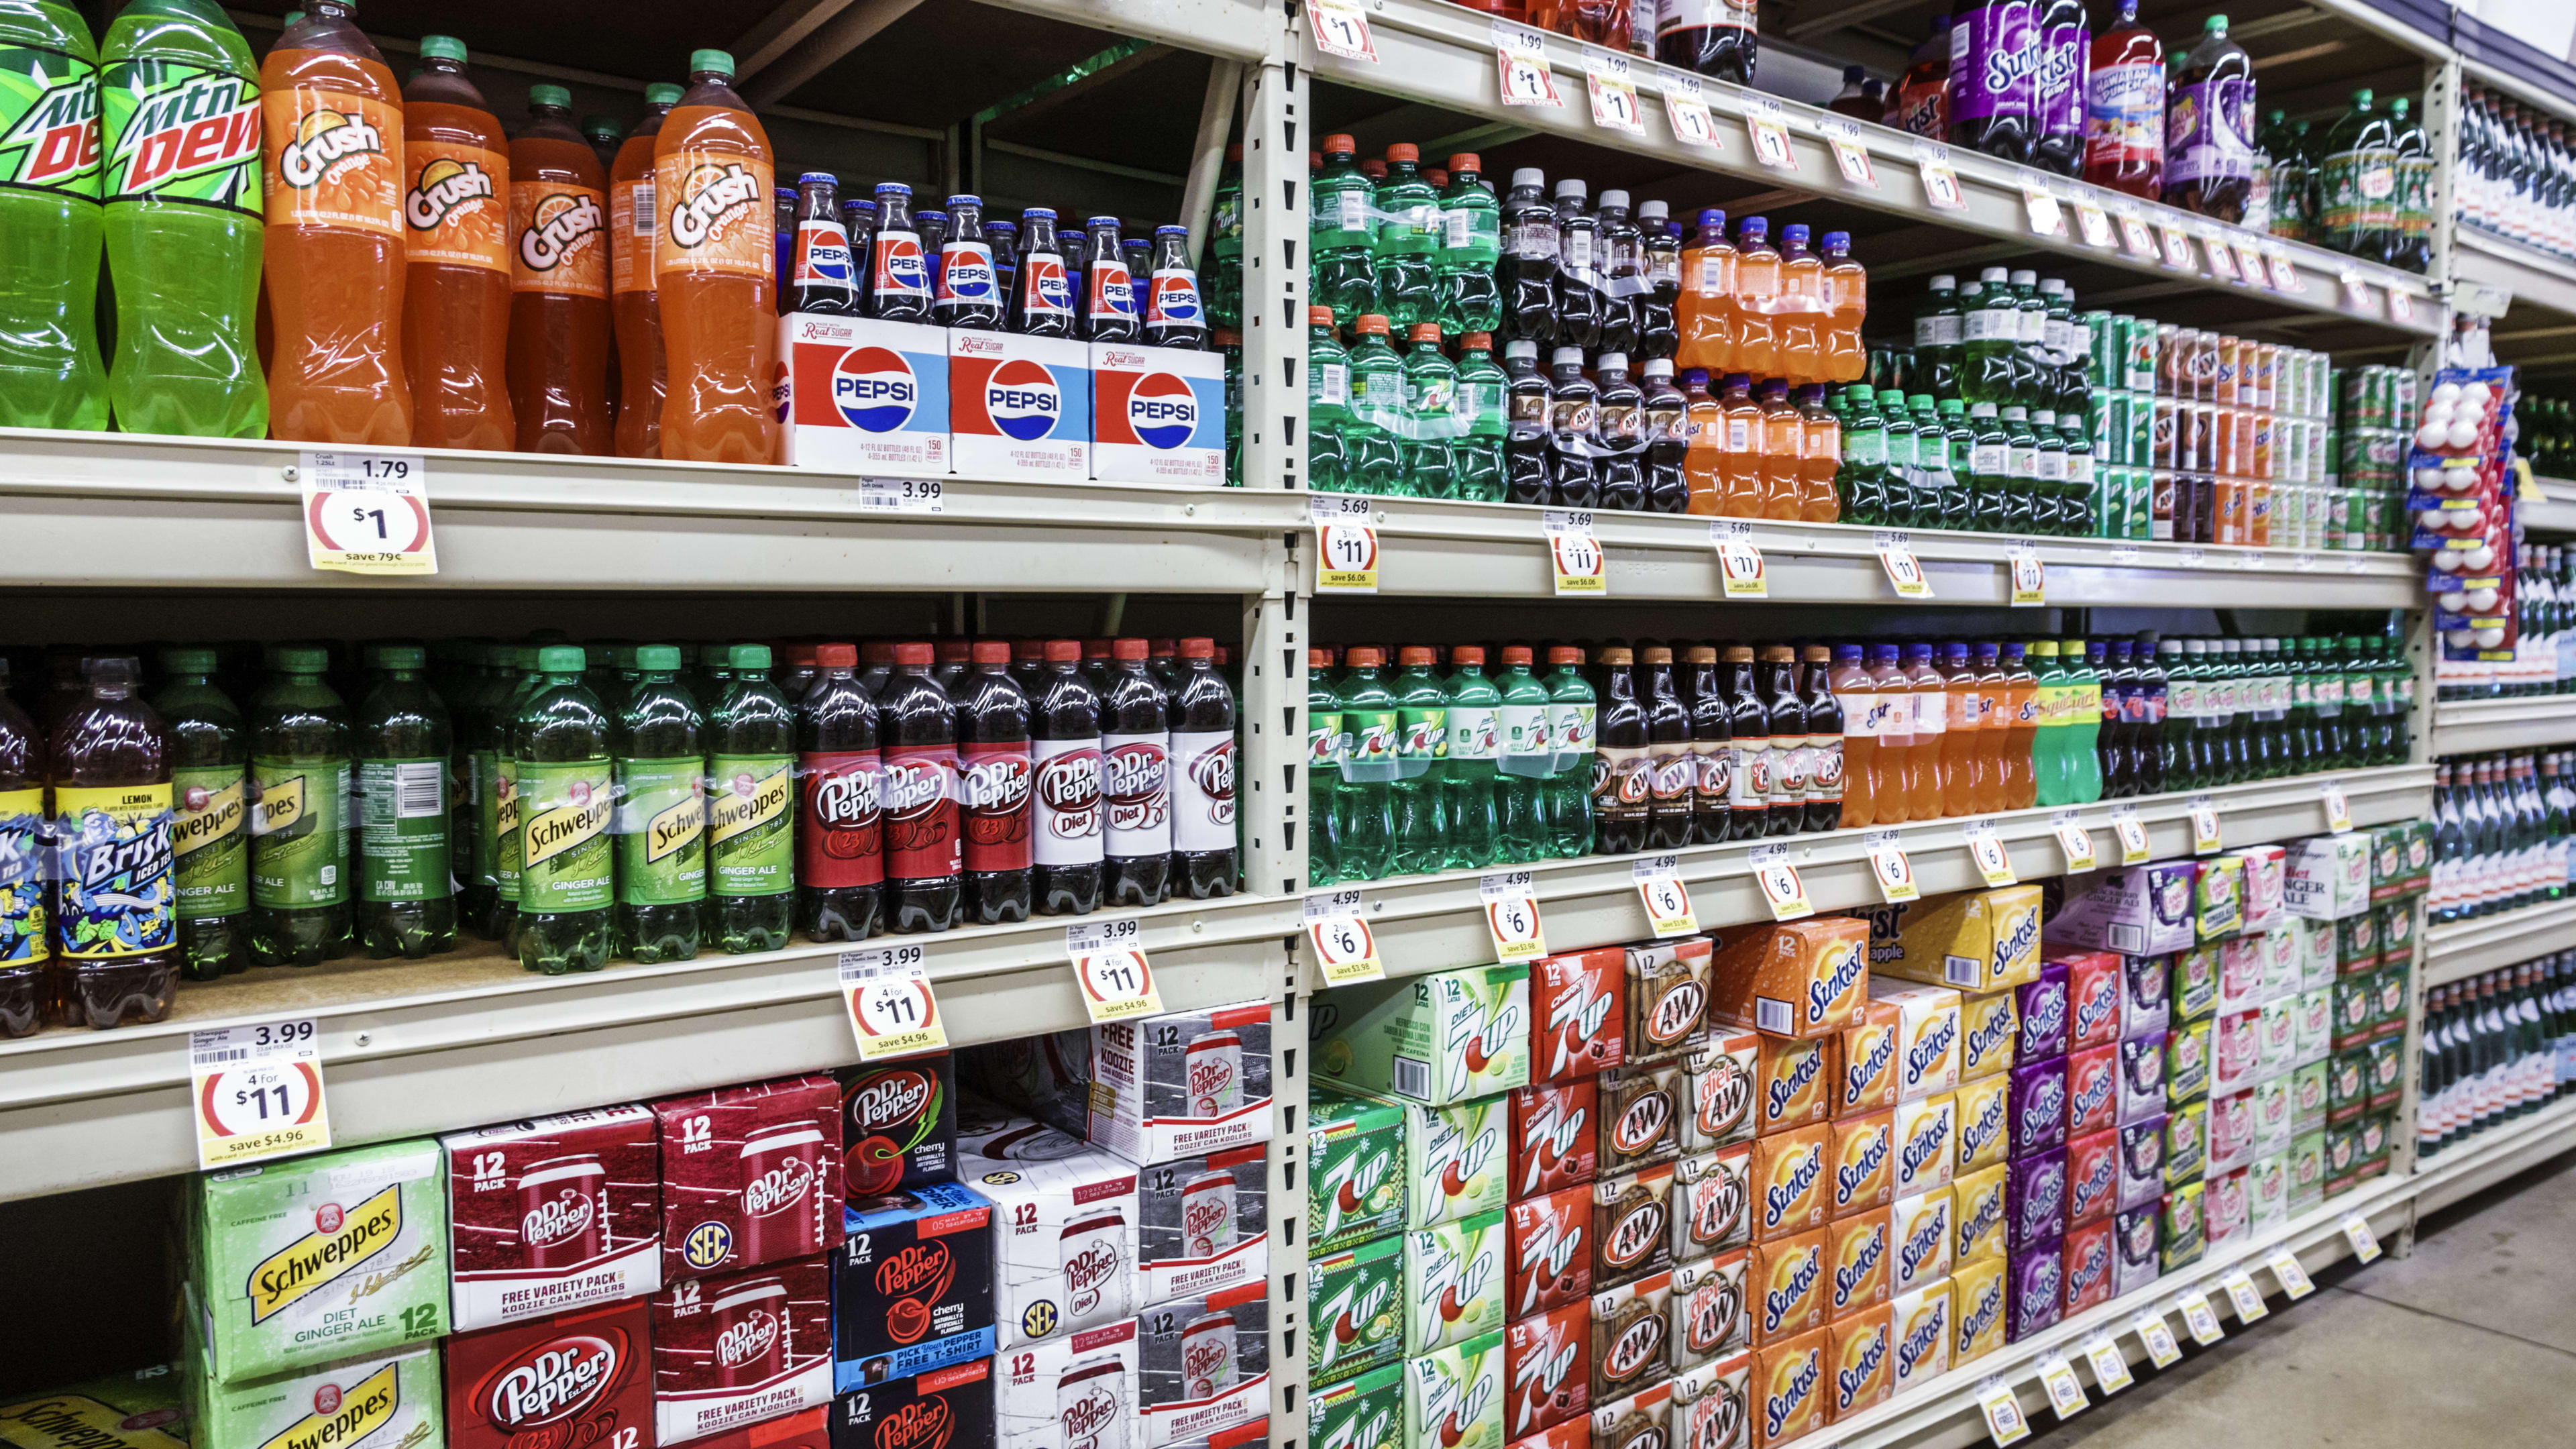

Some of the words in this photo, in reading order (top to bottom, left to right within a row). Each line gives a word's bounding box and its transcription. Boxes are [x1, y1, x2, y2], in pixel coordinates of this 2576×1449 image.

[1331, 17, 1354, 45] $1
[1519, 33, 1542, 50] 1.99
[1324, 43, 1348, 58] DOWN
[1348, 47, 1374, 62] DOWN
[1519, 71, 1538, 95] $1
[1680, 76, 1700, 93] 1.99
[122, 78, 236, 146] Mtn
[1684, 111, 1701, 135] $1
[1841, 123, 1859, 138] 1.99
[282, 114, 380, 189] Crush
[1931, 147, 1947, 160] 1.99
[326, 154, 371, 185] Orange
[407, 163, 492, 229] Crush
[673, 165, 759, 247] Crush
[445, 199, 484, 227] Orange
[708, 203, 750, 242] Orange
[521, 197, 603, 269] Crush
[560, 232, 596, 267] Orange
[948, 269, 991, 281] PEPSI
[1159, 294, 1197, 304] PEPSI
[802, 322, 830, 339] Real
[831, 328, 853, 337] SUGAR
[985, 342, 1004, 352] SUGAR
[1128, 356, 1145, 365] SUGAR
[837, 378, 914, 401] PEPSI
[989, 389, 1057, 411] PEPSI
[1131, 400, 1195, 421] PEPSI
[883, 444, 901, 453] BOTTLES
[928, 440, 941, 450] 150
[1071, 448, 1082, 458] 150
[362, 460, 409, 479] 1.79
[1208, 455, 1219, 465] 150
[902, 482, 941, 499] 3.99
[1341, 498, 1368, 514] 5.69
[354, 507, 387, 539] $1
[1568, 513, 1592, 526] 5.69
[1731, 523, 1751, 535] 5.69
[1891, 531, 1909, 543] 5.69
[345, 553, 376, 561] save
[378, 553, 402, 561] 79¢
[1338, 539, 1362, 562] $11
[1347, 574, 1366, 582] $6.06
[1355, 723, 1396, 759] 7UP
[1403, 720, 1446, 755] 7UP
[1556, 716, 1595, 751] 7UP
[991, 761, 1019, 784] Dr
[1123, 751, 1152, 772] Dr
[122, 794, 152, 805] LEMON
[970, 767, 1030, 810] Pepper
[1061, 814, 1087, 833] Diet
[1114, 806, 1139, 824] Diet
[1979, 818, 1996, 830] 4.99
[733, 830, 762, 846] SINCE
[765, 817, 784, 831] 1783
[981, 819, 1000, 835] 23
[842, 833, 860, 848] 23
[1769, 843, 1787, 855] 4.99
[136, 859, 159, 883] ICED
[719, 866, 756, 875] GINGER
[758, 865, 777, 874] ALE
[1655, 855, 1676, 868] 4.99
[215, 883, 235, 894] ALE
[552, 879, 594, 891] GINGER
[596, 875, 610, 885] ALE
[1506, 871, 1529, 885] 4.99
[1332, 890, 1360, 905] 4.99
[1104, 920, 1137, 938] 3.99
[1507, 912, 1524, 934] $6
[1334, 931, 1356, 954] $6
[1994, 904, 2039, 975] Sunkist
[882, 947, 921, 966] 3.99
[1870, 943, 1903, 962] apple
[1100, 967, 1135, 991] $11
[1352, 963, 1370, 973] $3.98
[1445, 978, 1460, 997] 12
[1550, 973, 1587, 1009] CHERRY
[1809, 941, 1864, 1022] Sunkist
[876, 996, 916, 1024] $11
[1451, 1000, 1474, 1026] DIET
[1658, 981, 1696, 1038] A&W
[2024, 981, 2065, 1052] Sunkist
[256, 1021, 313, 1046] 3.99
[878, 1038, 900, 1049] save
[901, 1032, 928, 1045] $4.96
[1158, 1025, 1179, 1046] 12
[1548, 988, 1613, 1080] 7UP
[1158, 1046, 1179, 1056] PACK
[1447, 1003, 1519, 1103] 7UP
[1907, 1012, 1957, 1085] Sunkist
[1101, 1047, 1135, 1076] KOOZIE
[1846, 1024, 1894, 1104] Sunkist
[248, 1075, 257, 1085] 4
[261, 1073, 279, 1084] for
[879, 1078, 908, 1101] Dr
[1700, 1058, 1734, 1098] diet
[1768, 1040, 1825, 1120] Sunkist
[236, 1084, 290, 1120] $11
[862, 1083, 924, 1128] Pepper
[1709, 1073, 1743, 1129] A&W
[682, 1115, 712, 1143] 12
[229, 1139, 262, 1152] save
[265, 1130, 304, 1146] $4.96
[684, 1140, 712, 1154] PACK
[914, 1142, 945, 1155] cherry
[472, 1151, 506, 1181] 12
[474, 1178, 506, 1193] PACK
[1766, 1142, 1823, 1228] Sunkist
[230, 1215, 268, 1227] CAFFEINE
[269, 1211, 288, 1221] FREE
[526, 1203, 589, 1246] Pepper
[1015, 1202, 1038, 1226] 12
[1016, 1224, 1038, 1236] PACK
[1615, 1203, 1655, 1261] A&W
[260, 1208, 392, 1305] Schweppes
[689, 1225, 727, 1265] SEC
[847, 1233, 873, 1258] 12
[849, 1255, 872, 1267] PACK
[502, 1289, 531, 1305] FREE
[534, 1278, 583, 1299] VARIETY
[586, 1272, 616, 1288] PACK
[502, 1299, 546, 1314] KOOZIE
[549, 1294, 572, 1305] CAN
[576, 1282, 625, 1299] KOOLERS
[933, 1302, 964, 1317] cherry
[1074, 1295, 1094, 1312] Diet
[323, 1307, 358, 1324] DIET
[399, 1302, 438, 1332] 12
[1025, 1304, 1056, 1336] SEC
[294, 1322, 354, 1343] GINGER
[357, 1314, 386, 1330] ALE
[405, 1326, 438, 1340] PACK
[897, 1347, 920, 1360] PICK
[944, 1331, 982, 1349] PEPPER
[897, 1354, 930, 1370] FREE
[934, 1340, 982, 1360] T-SHIRT
[535, 1347, 580, 1387] Dr
[505, 1350, 608, 1426] Pepper
[697, 1408, 723, 1423] FREE
[724, 1395, 768, 1415] VARIETY
[771, 1387, 797, 1403] PACK
